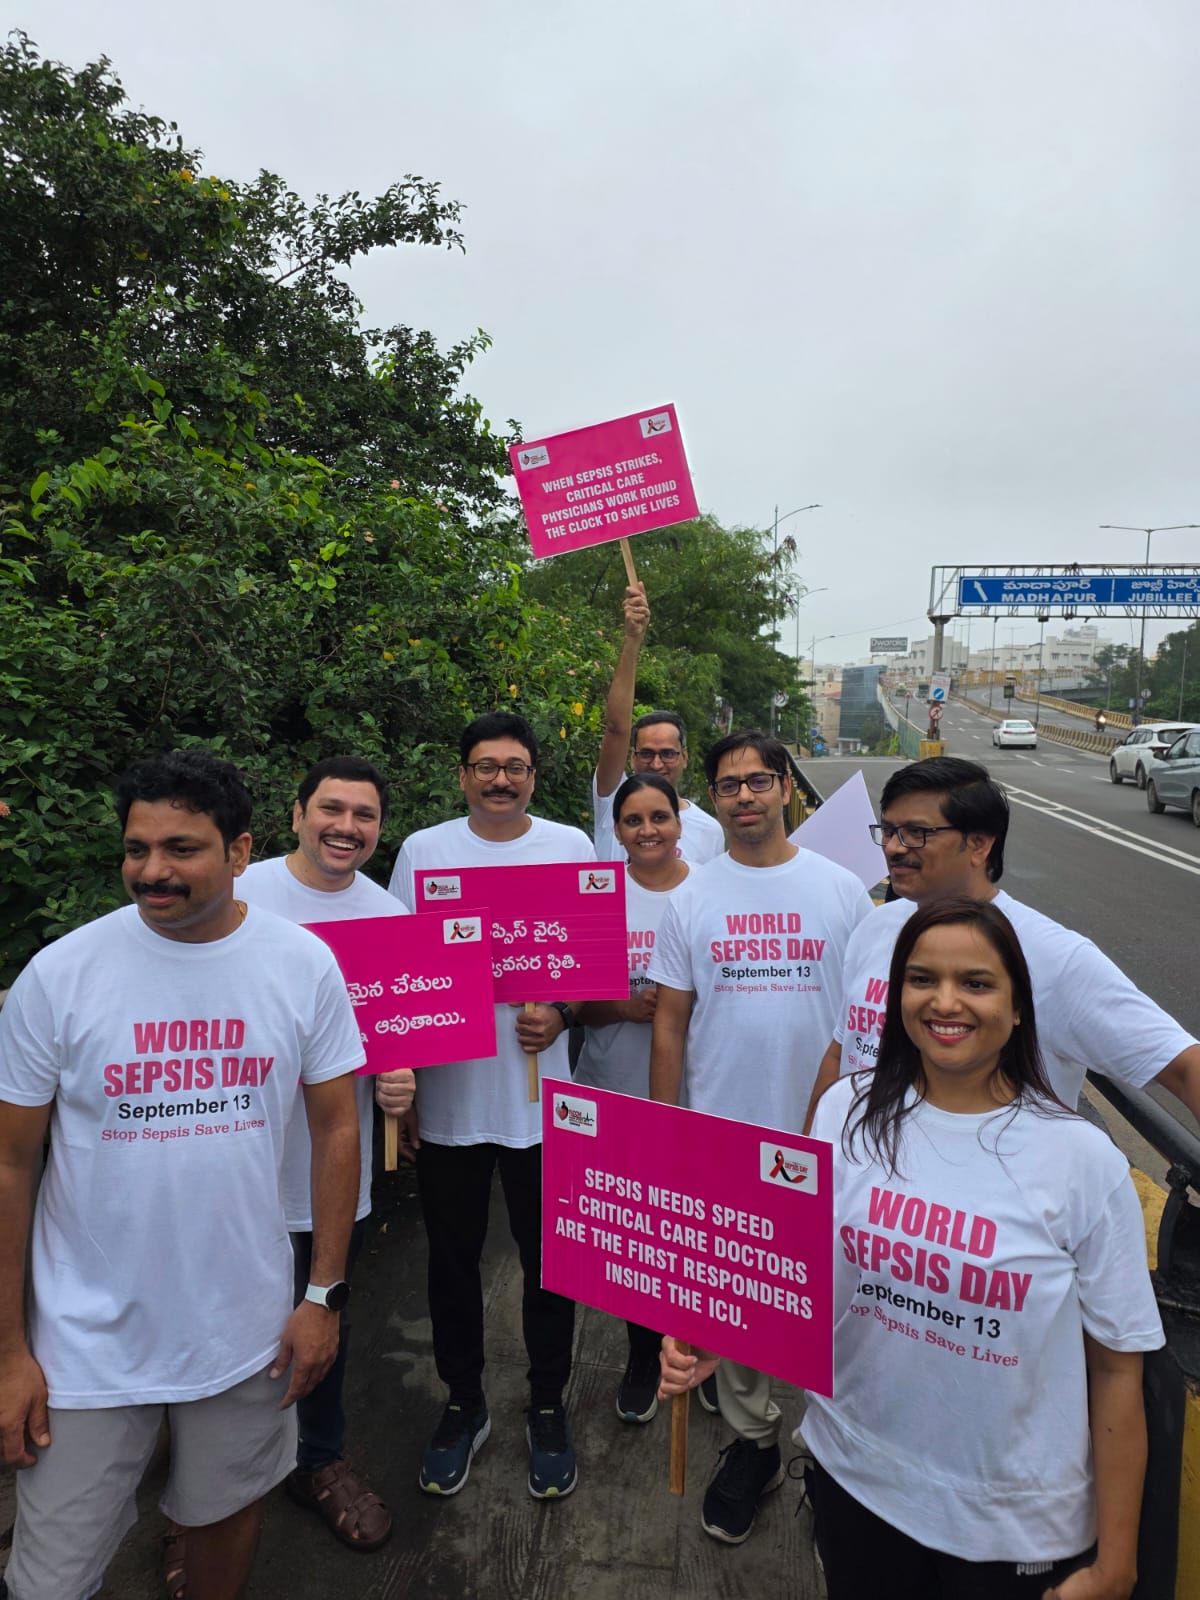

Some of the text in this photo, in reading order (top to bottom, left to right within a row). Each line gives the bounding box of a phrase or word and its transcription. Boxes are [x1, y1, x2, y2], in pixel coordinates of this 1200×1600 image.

[542, 452, 663, 493] WHEN SEPSIS STRIKES,
[566, 472, 645, 503] CRITICAL CARE
[541, 479, 677, 525] PHYSICIANS WORK ROUND
[545, 495, 680, 540] THE CLOCK TO SAVE LIVES
[1001, 593, 1097, 602] MADHAPUR
[1128, 593, 1193, 602] JUBILLEE
[726, 912, 802, 935] WORLD
[710, 938, 826, 963] SEPSIS DAY
[390, 973, 453, 994] చేతులు
[722, 966, 811, 980] September 13
[736, 984, 768, 994] Sepsis
[770, 983, 794, 992] Save
[797, 983, 822, 992] Lives
[133, 1018, 245, 1054] WORLD
[847, 1004, 887, 1038] SEPS
[103, 1056, 274, 1098] SEPSIS DAY
[118, 1094, 251, 1122] September 13
[101, 1118, 265, 1143] Stop Sepsis Save Lives
[584, 1167, 774, 1241] SEPSIS NEEDS SPEED
[868, 1186, 997, 1259] WORLD
[578, 1195, 654, 1236] CRITICAL
[660, 1219, 707, 1253] CARE
[714, 1237, 808, 1285] DOCTORS
[555, 1217, 813, 1320] ARE THE FIRST RESPONDERS
[839, 1225, 1033, 1312] SEPSIS DAY
[605, 1261, 748, 1330] INSIDE THE ICU.
[857, 1275, 1001, 1339] eptember 13
[850, 1303, 1019, 1367] op Sepsis Save Lives
